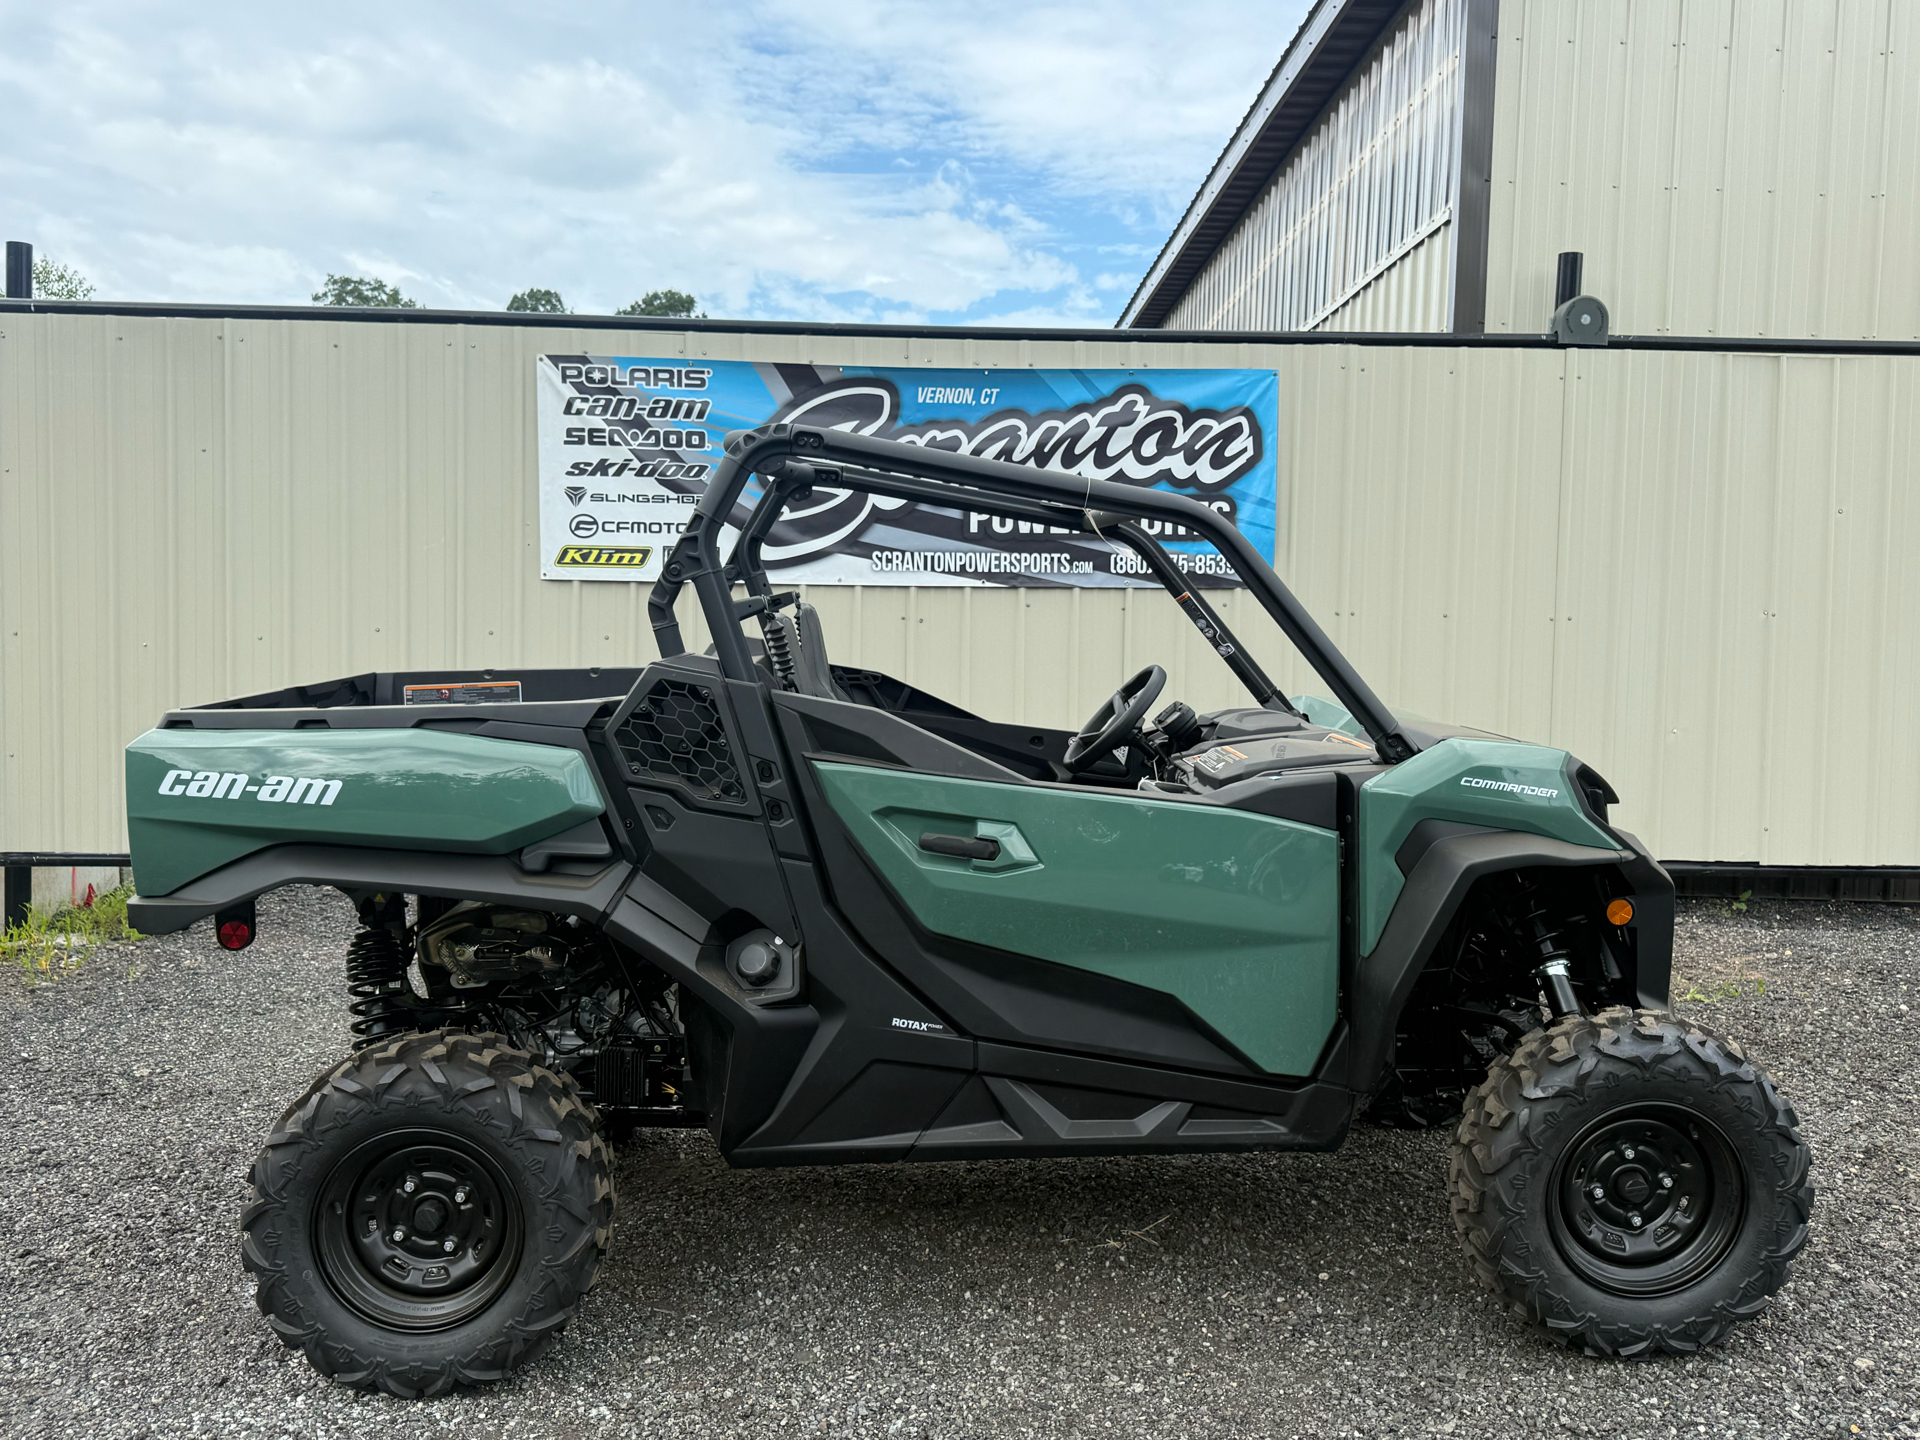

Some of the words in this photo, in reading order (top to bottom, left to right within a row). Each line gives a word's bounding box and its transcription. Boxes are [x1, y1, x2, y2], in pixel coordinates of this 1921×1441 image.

[560, 364, 709, 389] POLARIS
[917, 386, 976, 406] VERNON,
[980, 387, 1000, 404] CT
[563, 396, 711, 421] can-am
[564, 458, 710, 480] ski-doo
[158, 769, 343, 806] can-am
[1460, 776, 1558, 798] COMMANDER
[891, 1017, 928, 1031] ROTAX
